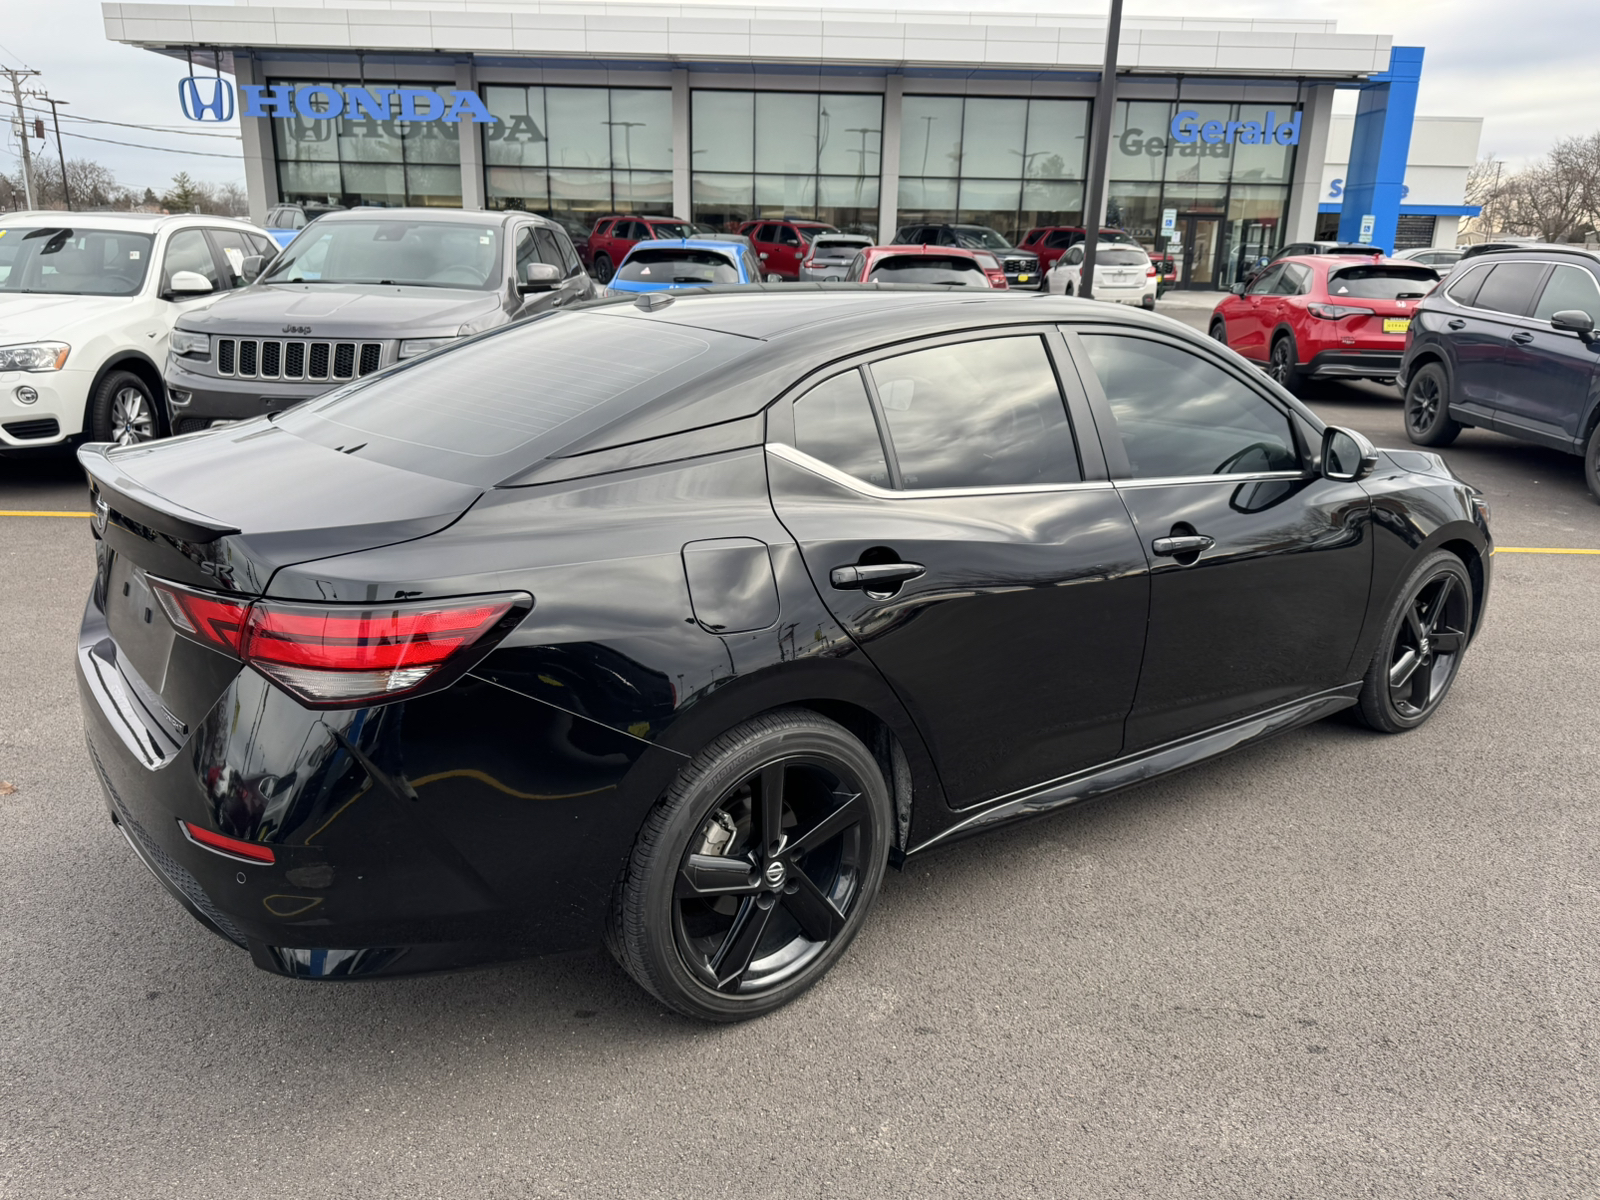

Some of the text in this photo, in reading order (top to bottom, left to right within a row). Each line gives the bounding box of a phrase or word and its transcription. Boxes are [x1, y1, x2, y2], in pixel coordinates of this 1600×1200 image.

[240, 84, 498, 123] HONDA
[1171, 109, 1303, 146] Gerald
[282, 324, 313, 335] Jeep
[200, 561, 234, 582] SR
